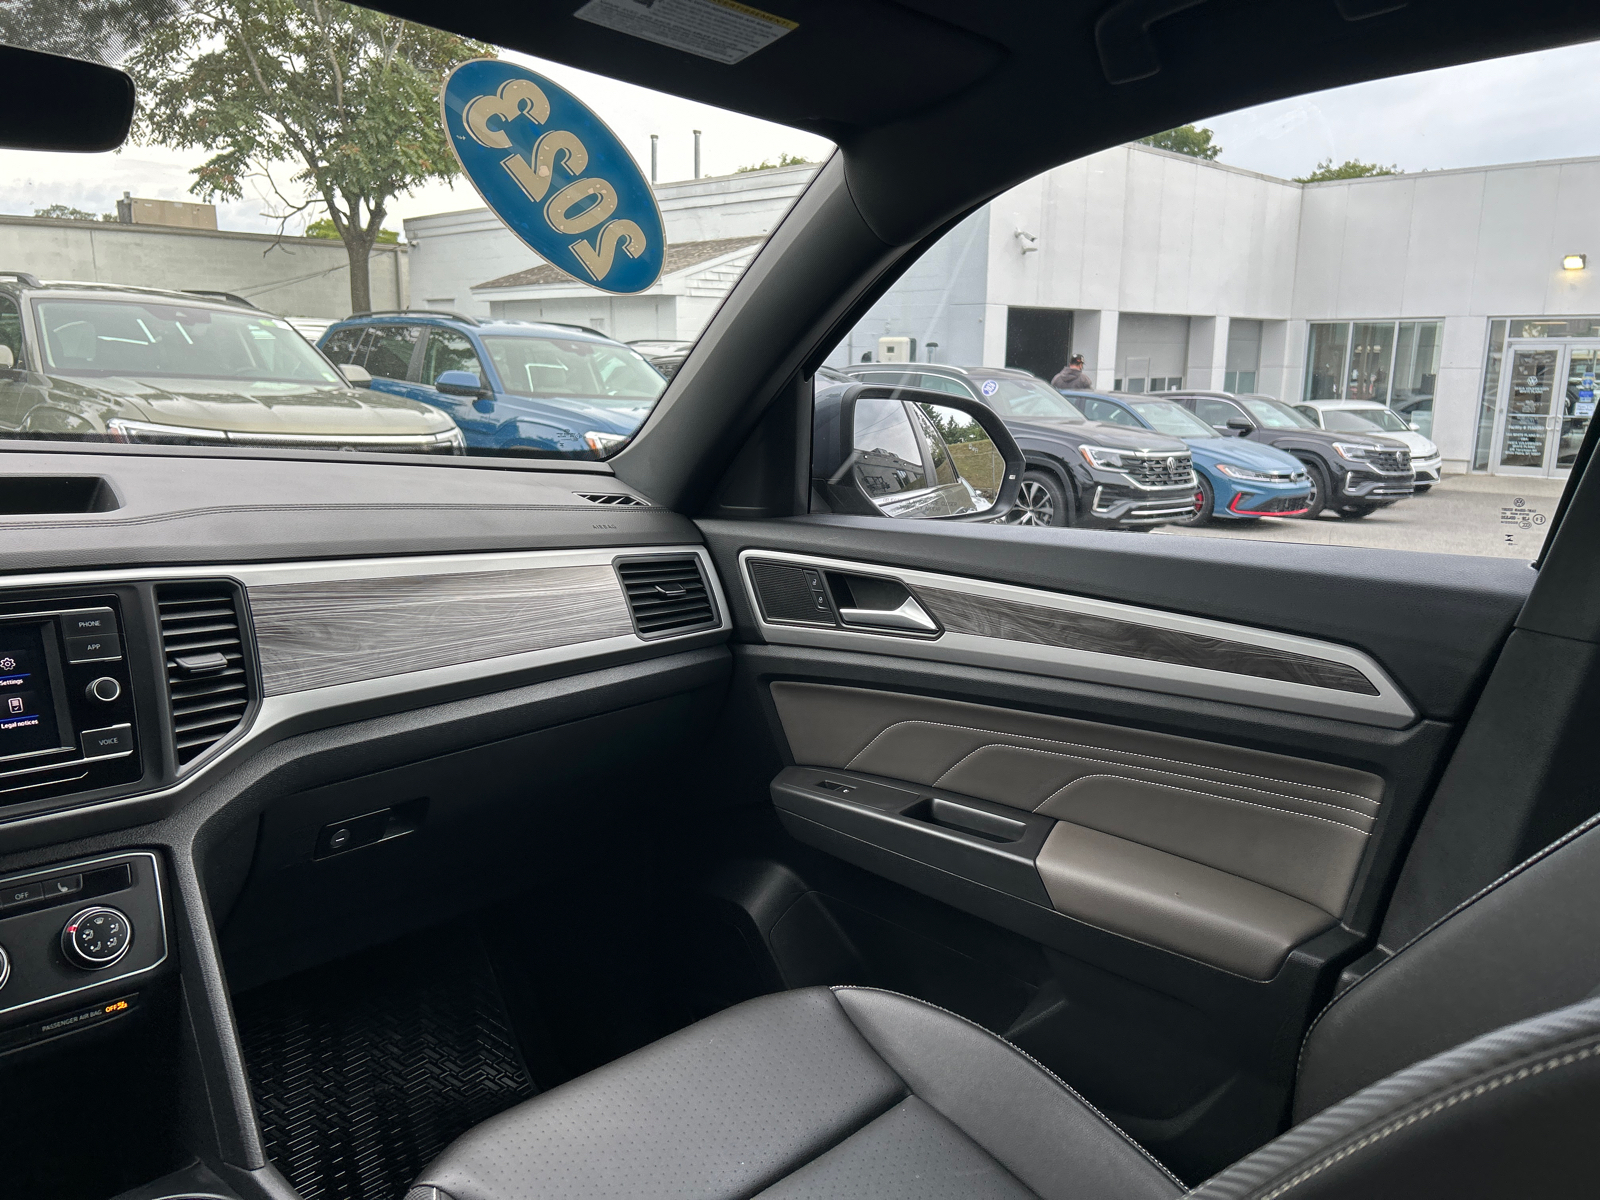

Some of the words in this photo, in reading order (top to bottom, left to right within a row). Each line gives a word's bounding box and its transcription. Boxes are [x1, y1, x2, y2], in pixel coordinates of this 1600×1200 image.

[99, 738, 118, 746] VOICE
[15, 892, 29, 900] OFF
[42, 1016, 78, 1032] PASSENGER
